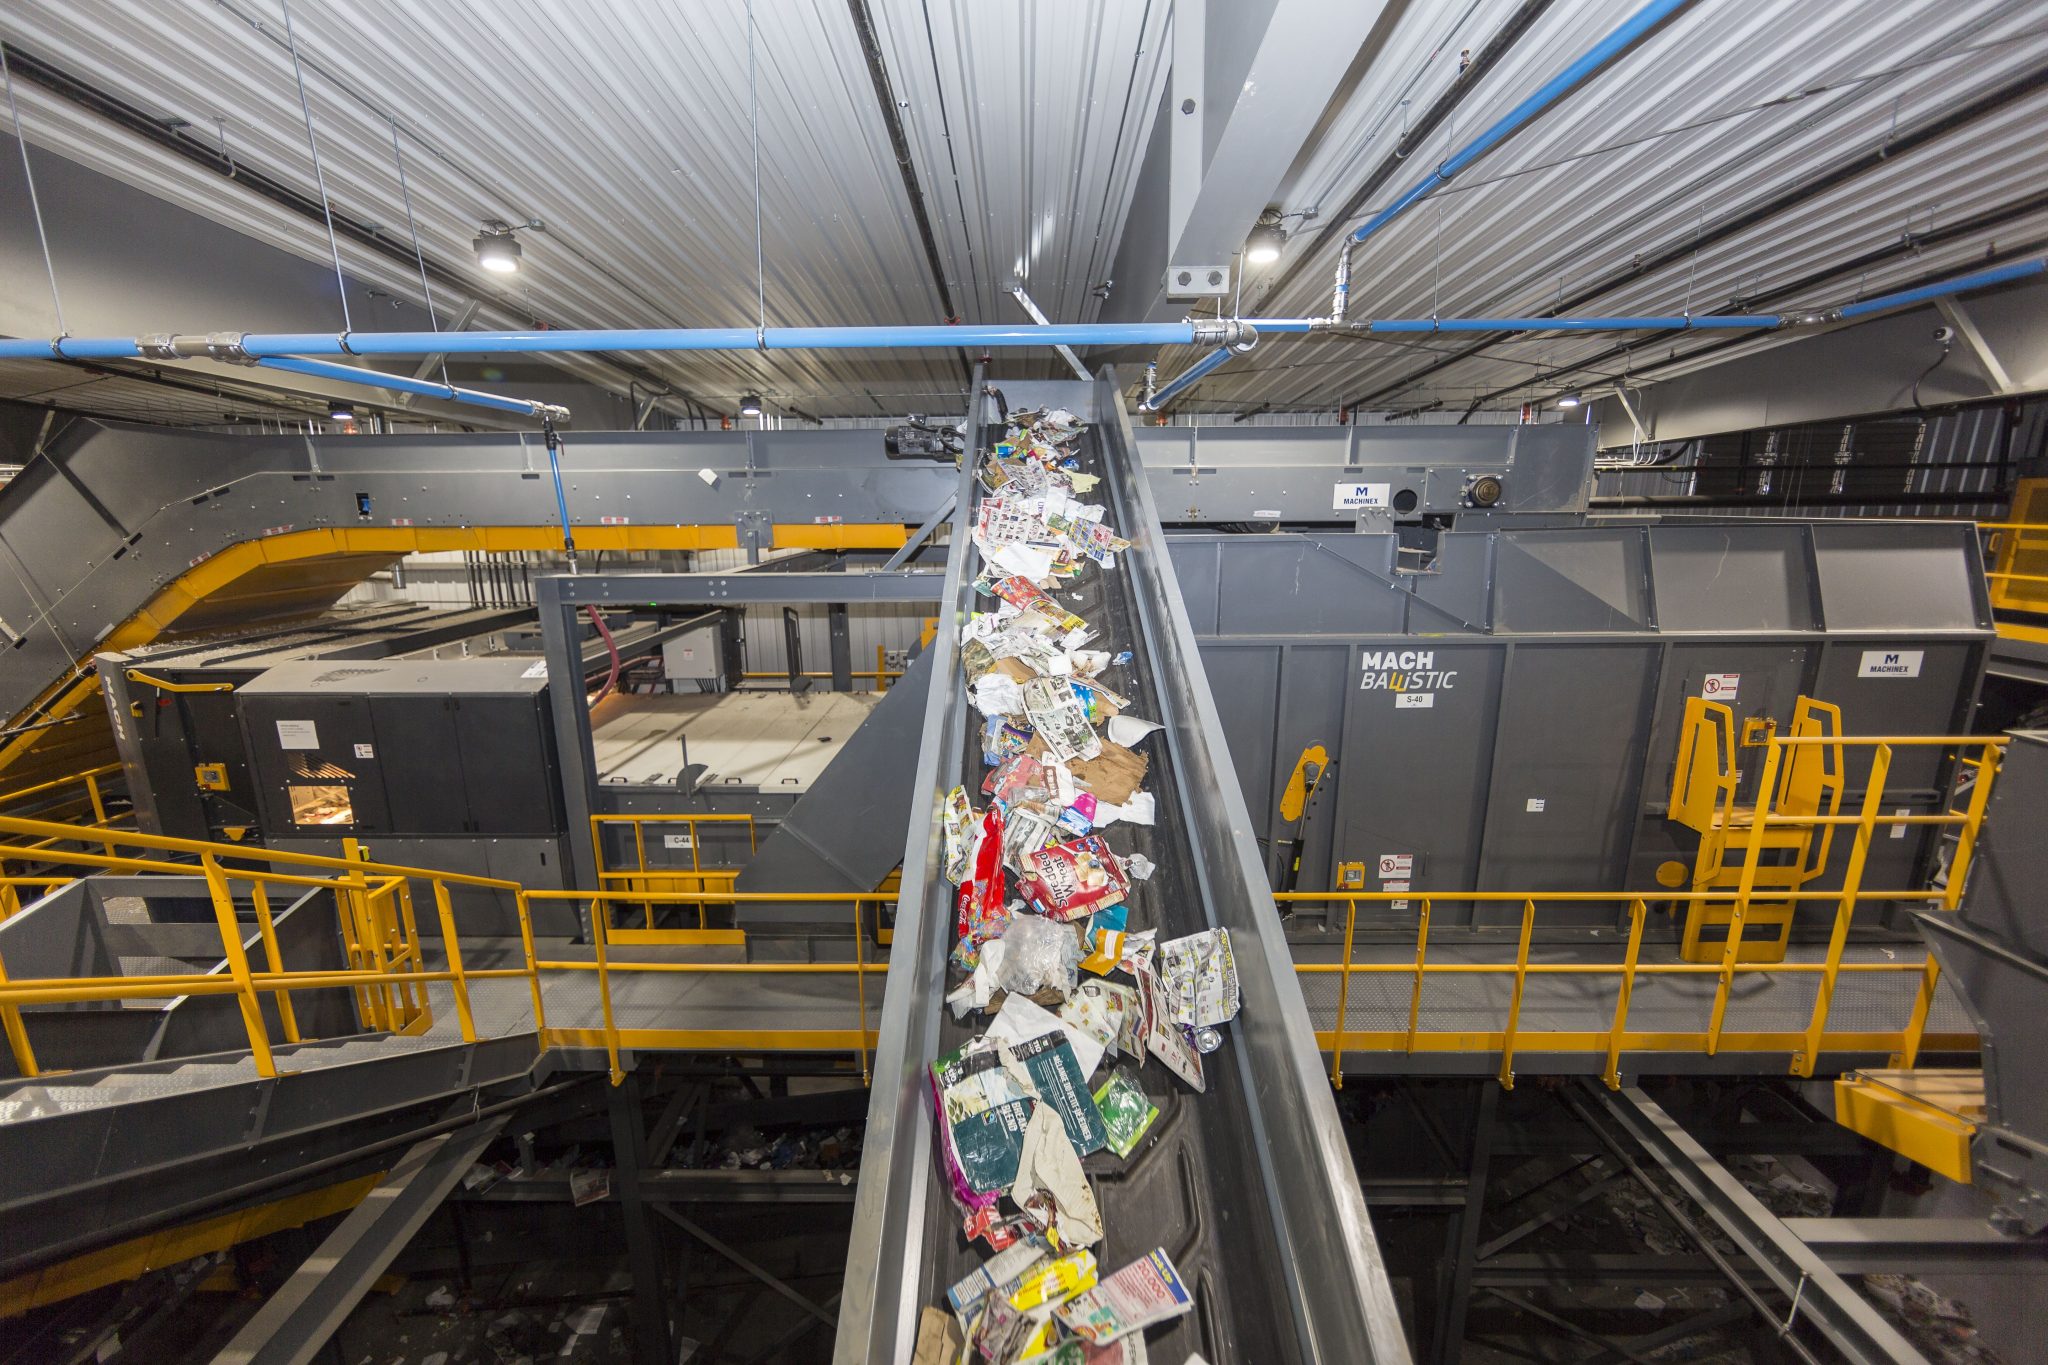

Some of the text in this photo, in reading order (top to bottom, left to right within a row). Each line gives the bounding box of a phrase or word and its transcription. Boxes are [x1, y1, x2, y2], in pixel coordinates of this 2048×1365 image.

[1361, 651, 1434, 670] MACH
[1869, 665, 1909, 673] MACHINEX
[104, 675, 126, 740] MACH
[1406, 695, 1423, 703] S-40
[674, 836, 690, 844] C-44
[1037, 852, 1068, 908] Shredded
[1053, 856, 1076, 898] Wheat
[1224, 951, 1233, 969] OFF
[1000, 1103, 1018, 1132] BLEND
[1011, 1100, 1029, 1135] BREAK
